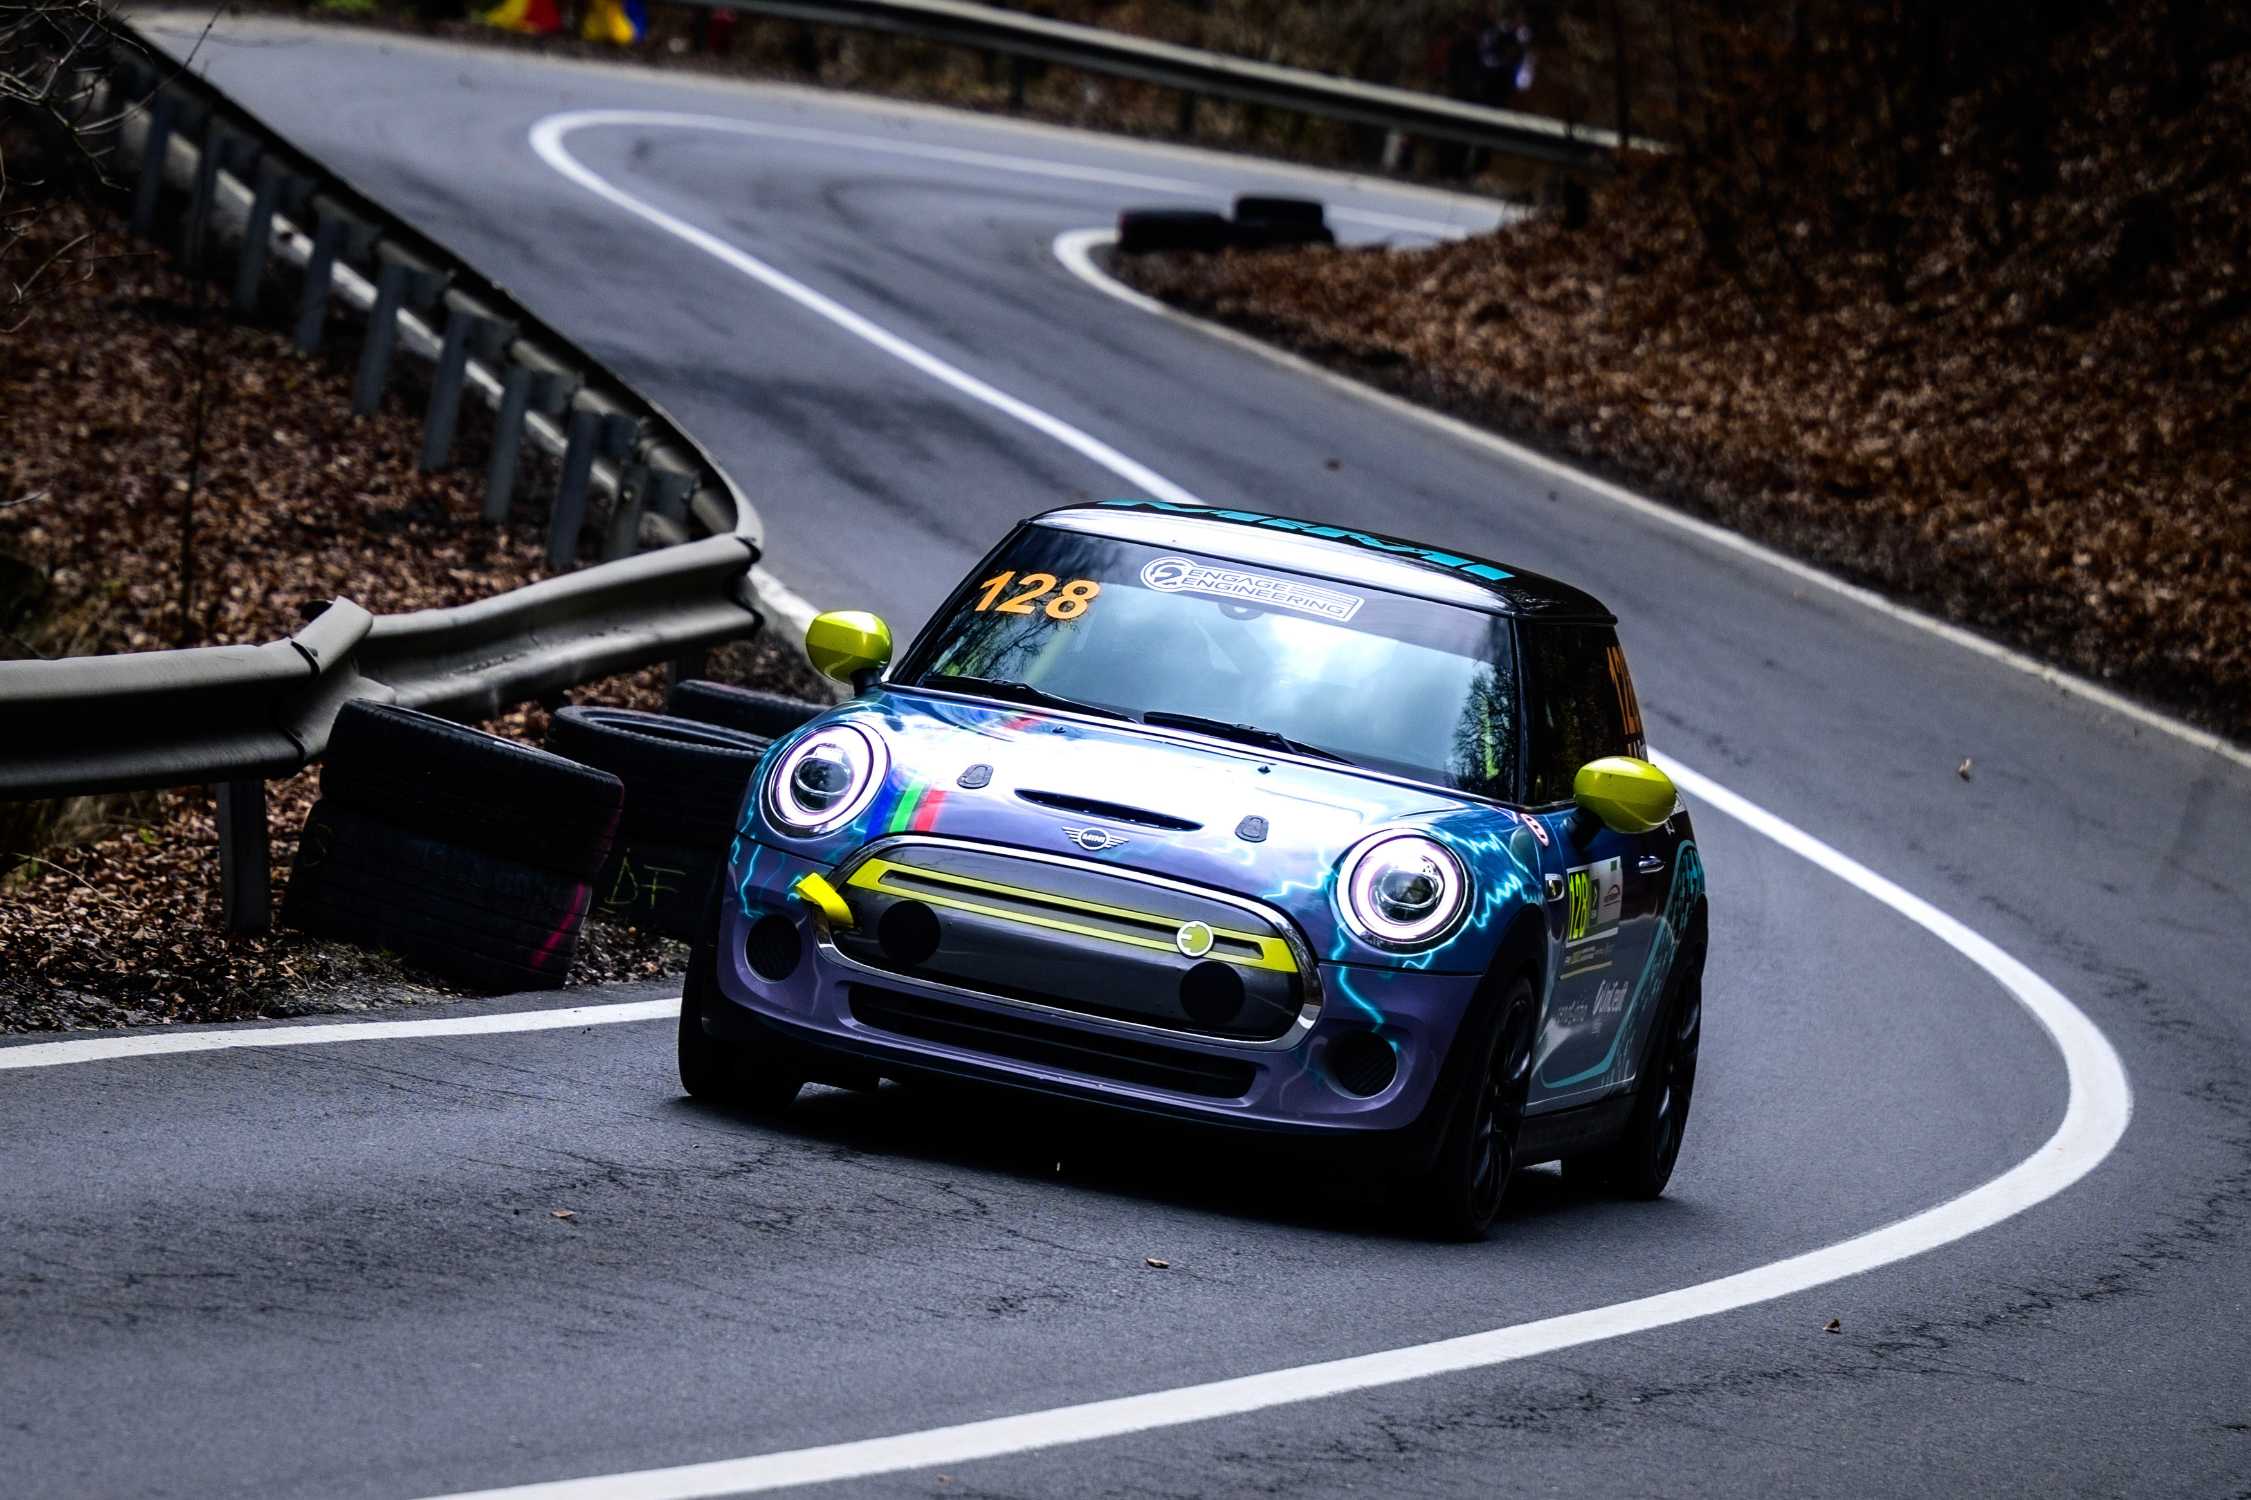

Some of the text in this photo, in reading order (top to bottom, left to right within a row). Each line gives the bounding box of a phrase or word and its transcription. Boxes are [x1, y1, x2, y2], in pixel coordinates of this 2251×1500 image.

[974, 570, 1101, 620] 128
[1181, 577, 1344, 614] ENGINEERING
[1188, 569, 1290, 592] ENGAGE
[1568, 872, 1590, 942] 128
